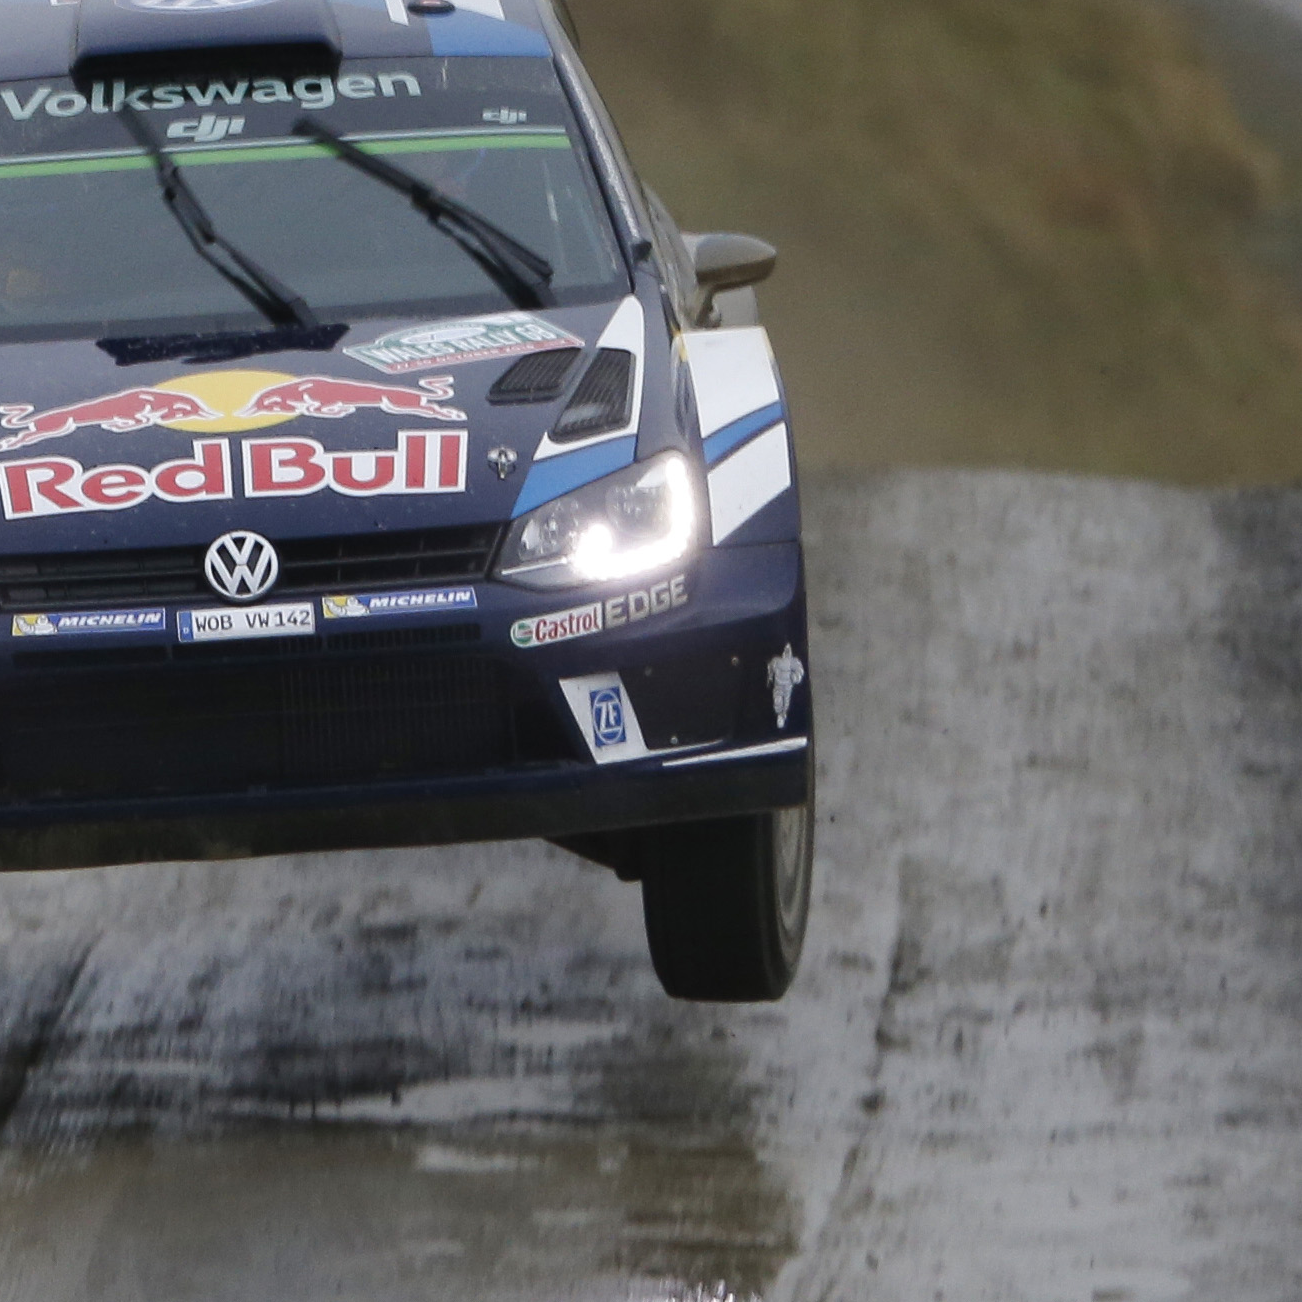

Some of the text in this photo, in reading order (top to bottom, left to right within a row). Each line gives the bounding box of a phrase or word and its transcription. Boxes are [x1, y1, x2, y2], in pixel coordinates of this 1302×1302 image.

[0, 69, 422, 121] Volkswagen
[358, 341, 456, 364] WALES
[1, 432, 462, 516] Red Bull
[370, 590, 472, 609] MICHELIN
[533, 576, 689, 643] Castrol EDGE
[57, 611, 163, 627] MICHELIN
[194, 609, 312, 633] WOB VW 142
[595, 701, 622, 733] ZF
